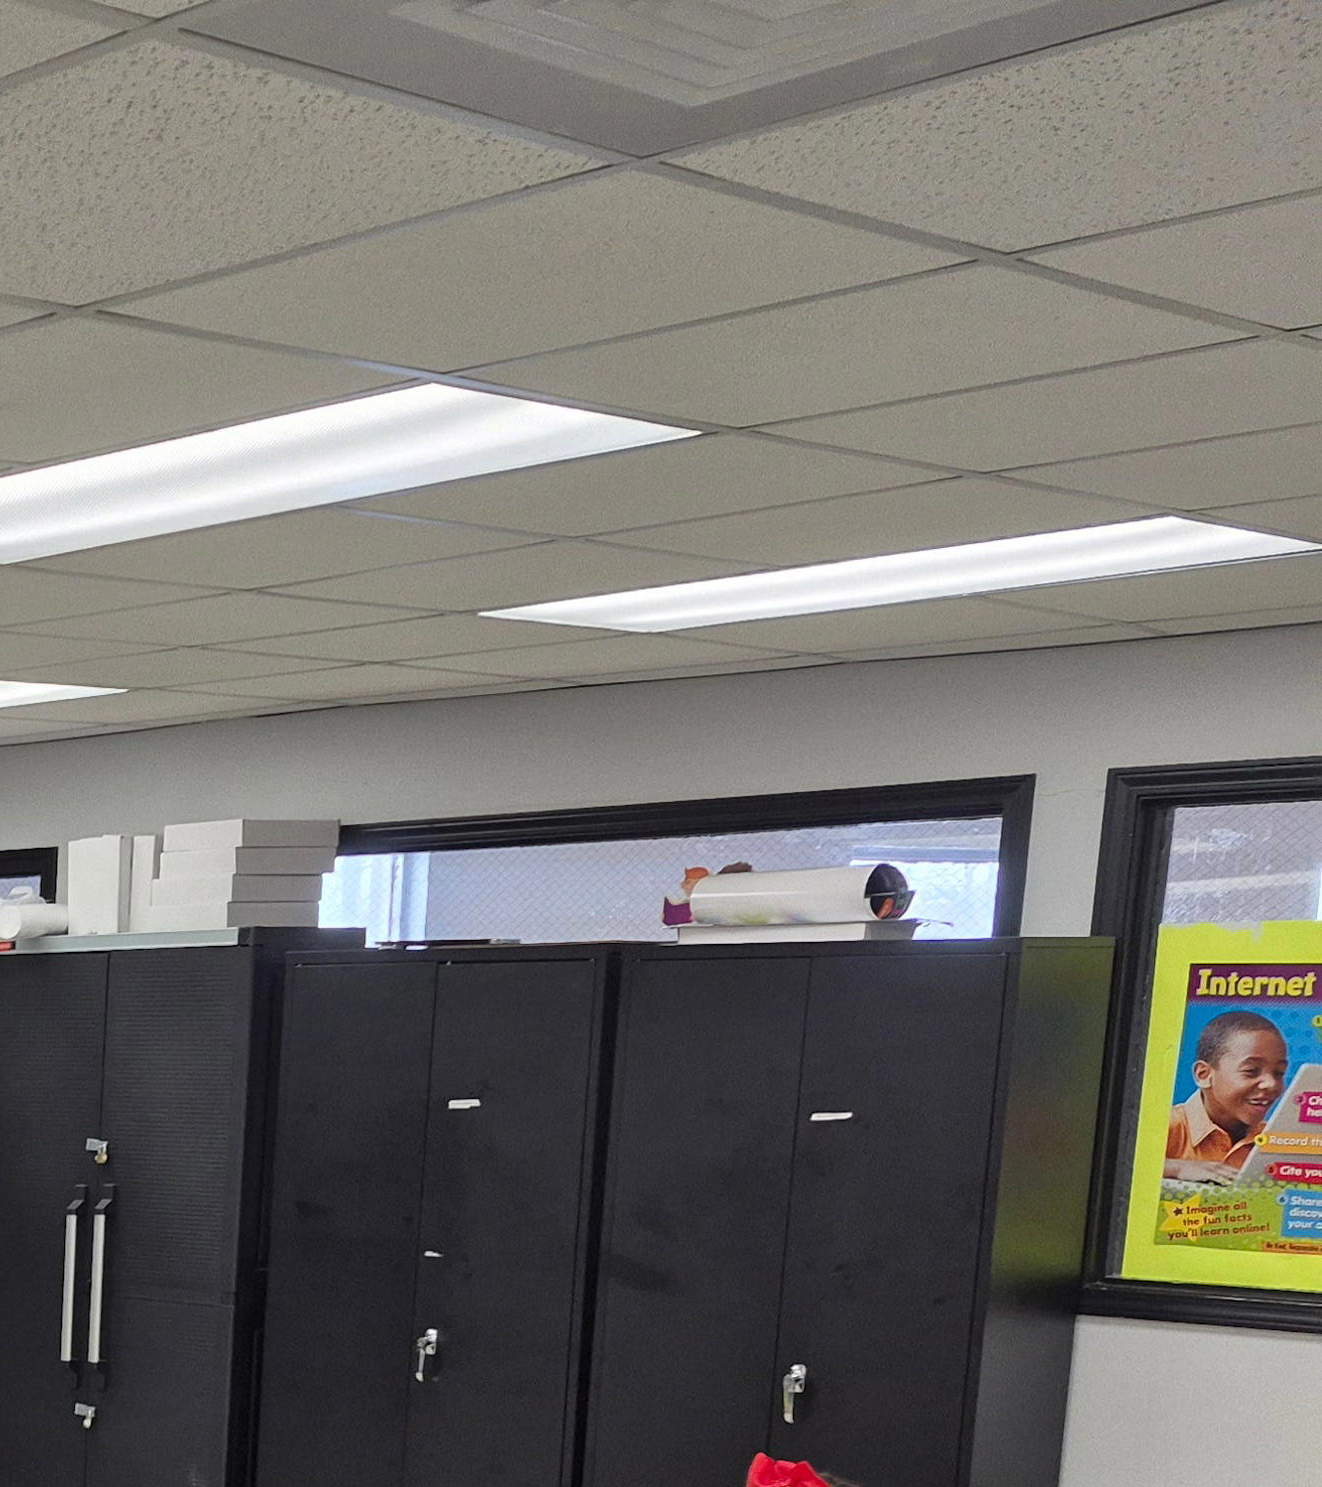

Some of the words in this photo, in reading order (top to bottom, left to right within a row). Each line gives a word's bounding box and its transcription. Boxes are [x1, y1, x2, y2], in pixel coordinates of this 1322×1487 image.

[1196, 968, 1317, 996] Internet
[1270, 1136, 1308, 1146] Record
[1186, 1205, 1230, 1215] Imagine
[1233, 1202, 1247, 1210] all
[1183, 1218, 1199, 1226] the
[1204, 1216, 1221, 1225] fun
[1225, 1214, 1252, 1222] facts
[1168, 1228, 1198, 1240] you'll
[1200, 1227, 1229, 1236] learn
[1232, 1223, 1270, 1234] online!
